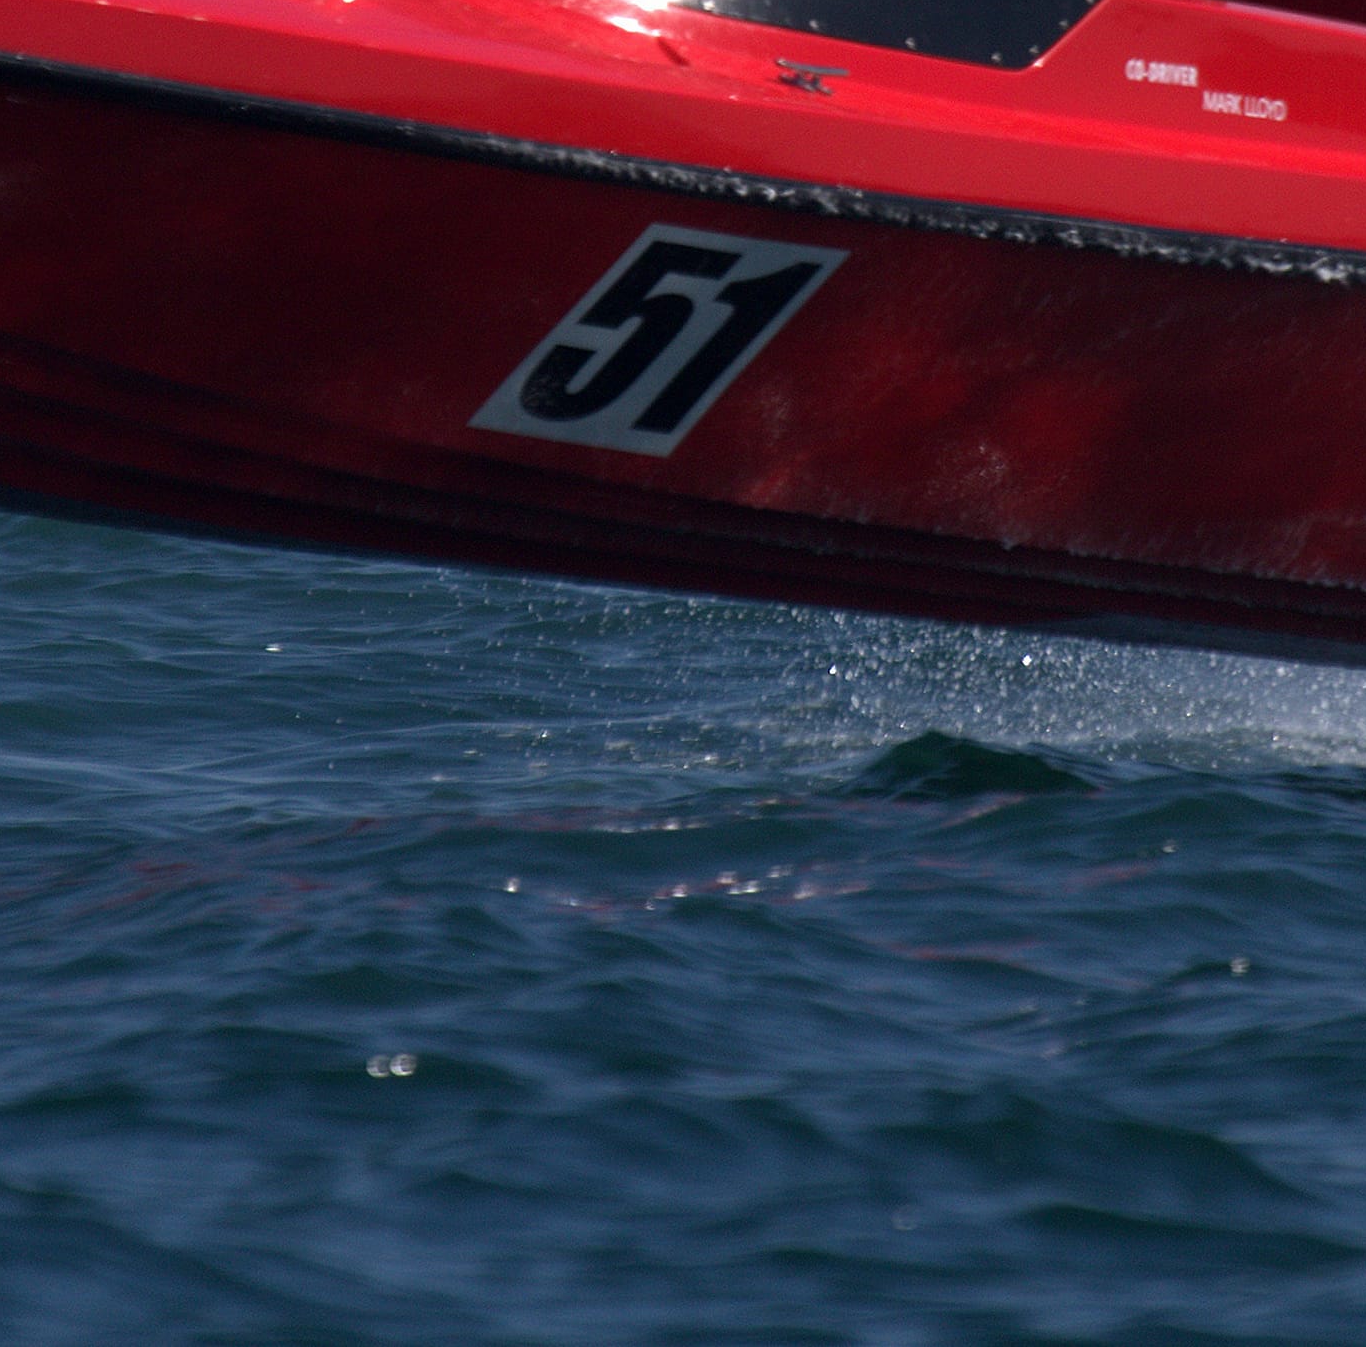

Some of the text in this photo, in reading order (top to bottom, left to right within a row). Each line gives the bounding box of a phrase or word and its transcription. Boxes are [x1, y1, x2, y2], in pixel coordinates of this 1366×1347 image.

[1125, 58, 1198, 87] CO-DRIVER
[1202, 90, 1288, 121] MARK LLOYD
[519, 240, 823, 434] 51
